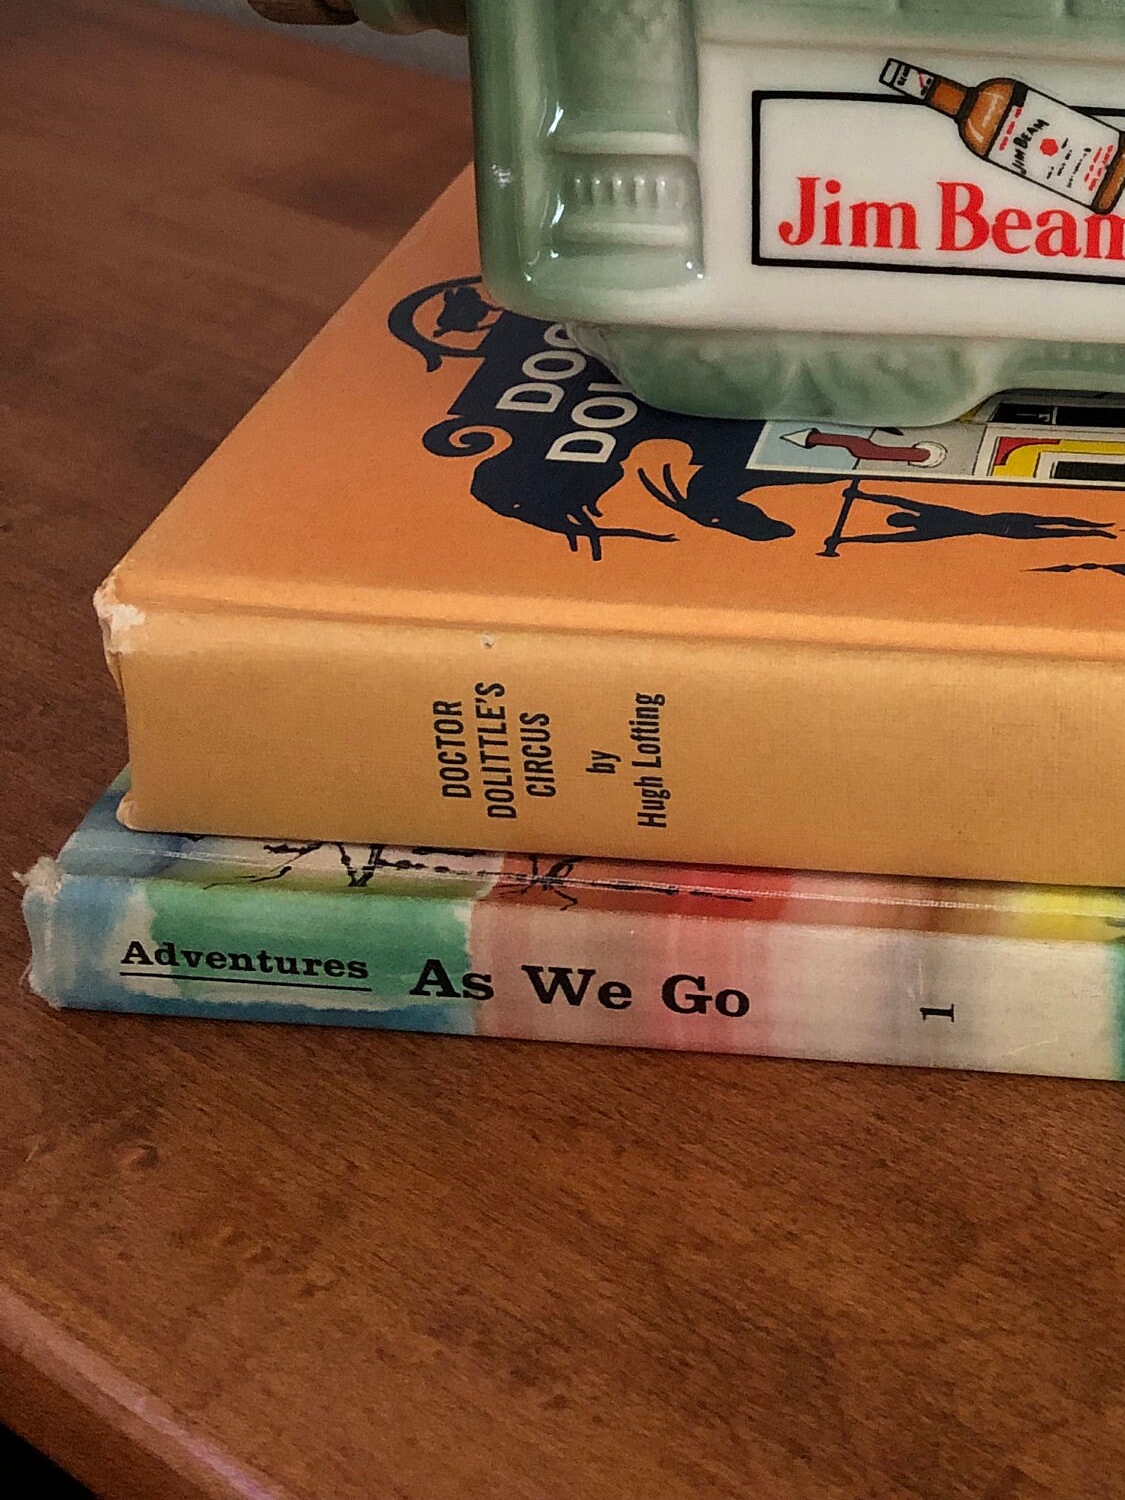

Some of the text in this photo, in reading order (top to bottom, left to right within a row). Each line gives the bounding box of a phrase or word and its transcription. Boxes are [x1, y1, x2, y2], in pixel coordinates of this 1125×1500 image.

[1013, 119, 1049, 148] BEAM
[778, 176, 919, 250] Jim
[433, 701, 472, 798] DOCTOR
[475, 682, 517, 819] DOLITTLE'S
[519, 712, 557, 797] CIRCUS
[586, 750, 622, 774] by
[629, 692, 671, 828] Hugh Lofting
[121, 940, 369, 980] Adventures
[410, 959, 494, 1001] As
[522, 963, 633, 1011] We
[661, 974, 752, 1019] Go
